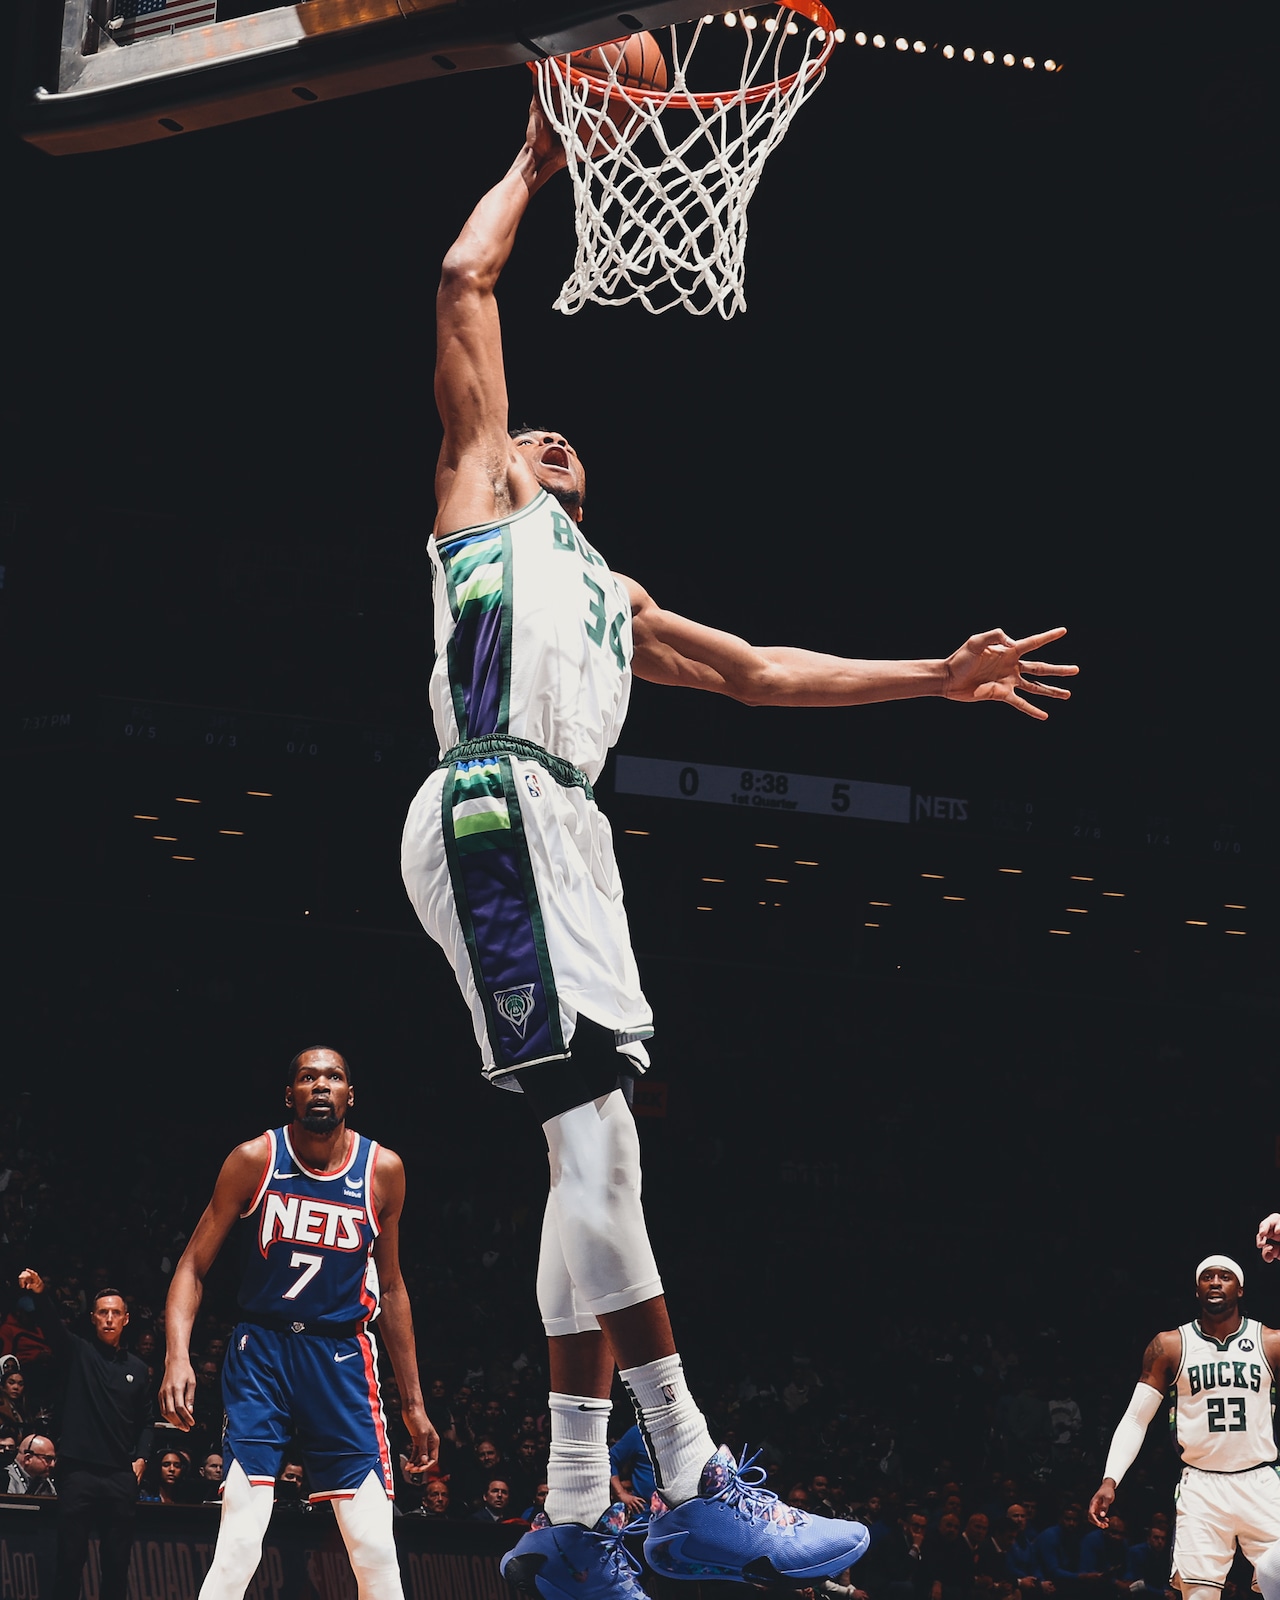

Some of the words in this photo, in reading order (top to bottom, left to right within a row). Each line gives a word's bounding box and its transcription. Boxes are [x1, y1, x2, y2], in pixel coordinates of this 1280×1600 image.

[50, 713, 71, 728] PM
[678, 767, 700, 797] 0
[740, 771, 789, 795] 8:38
[730, 793, 748, 805] 1st
[752, 795, 798, 810] Quarter
[831, 783, 851, 812] 5
[915, 795, 969, 822] NETS
[259, 1191, 367, 1258] NETS
[282, 1251, 324, 1300] 7
[1188, 1361, 1261, 1396] BUCKS
[1207, 1398, 1247, 1432] 23
[0, 1540, 39, 1600] App
